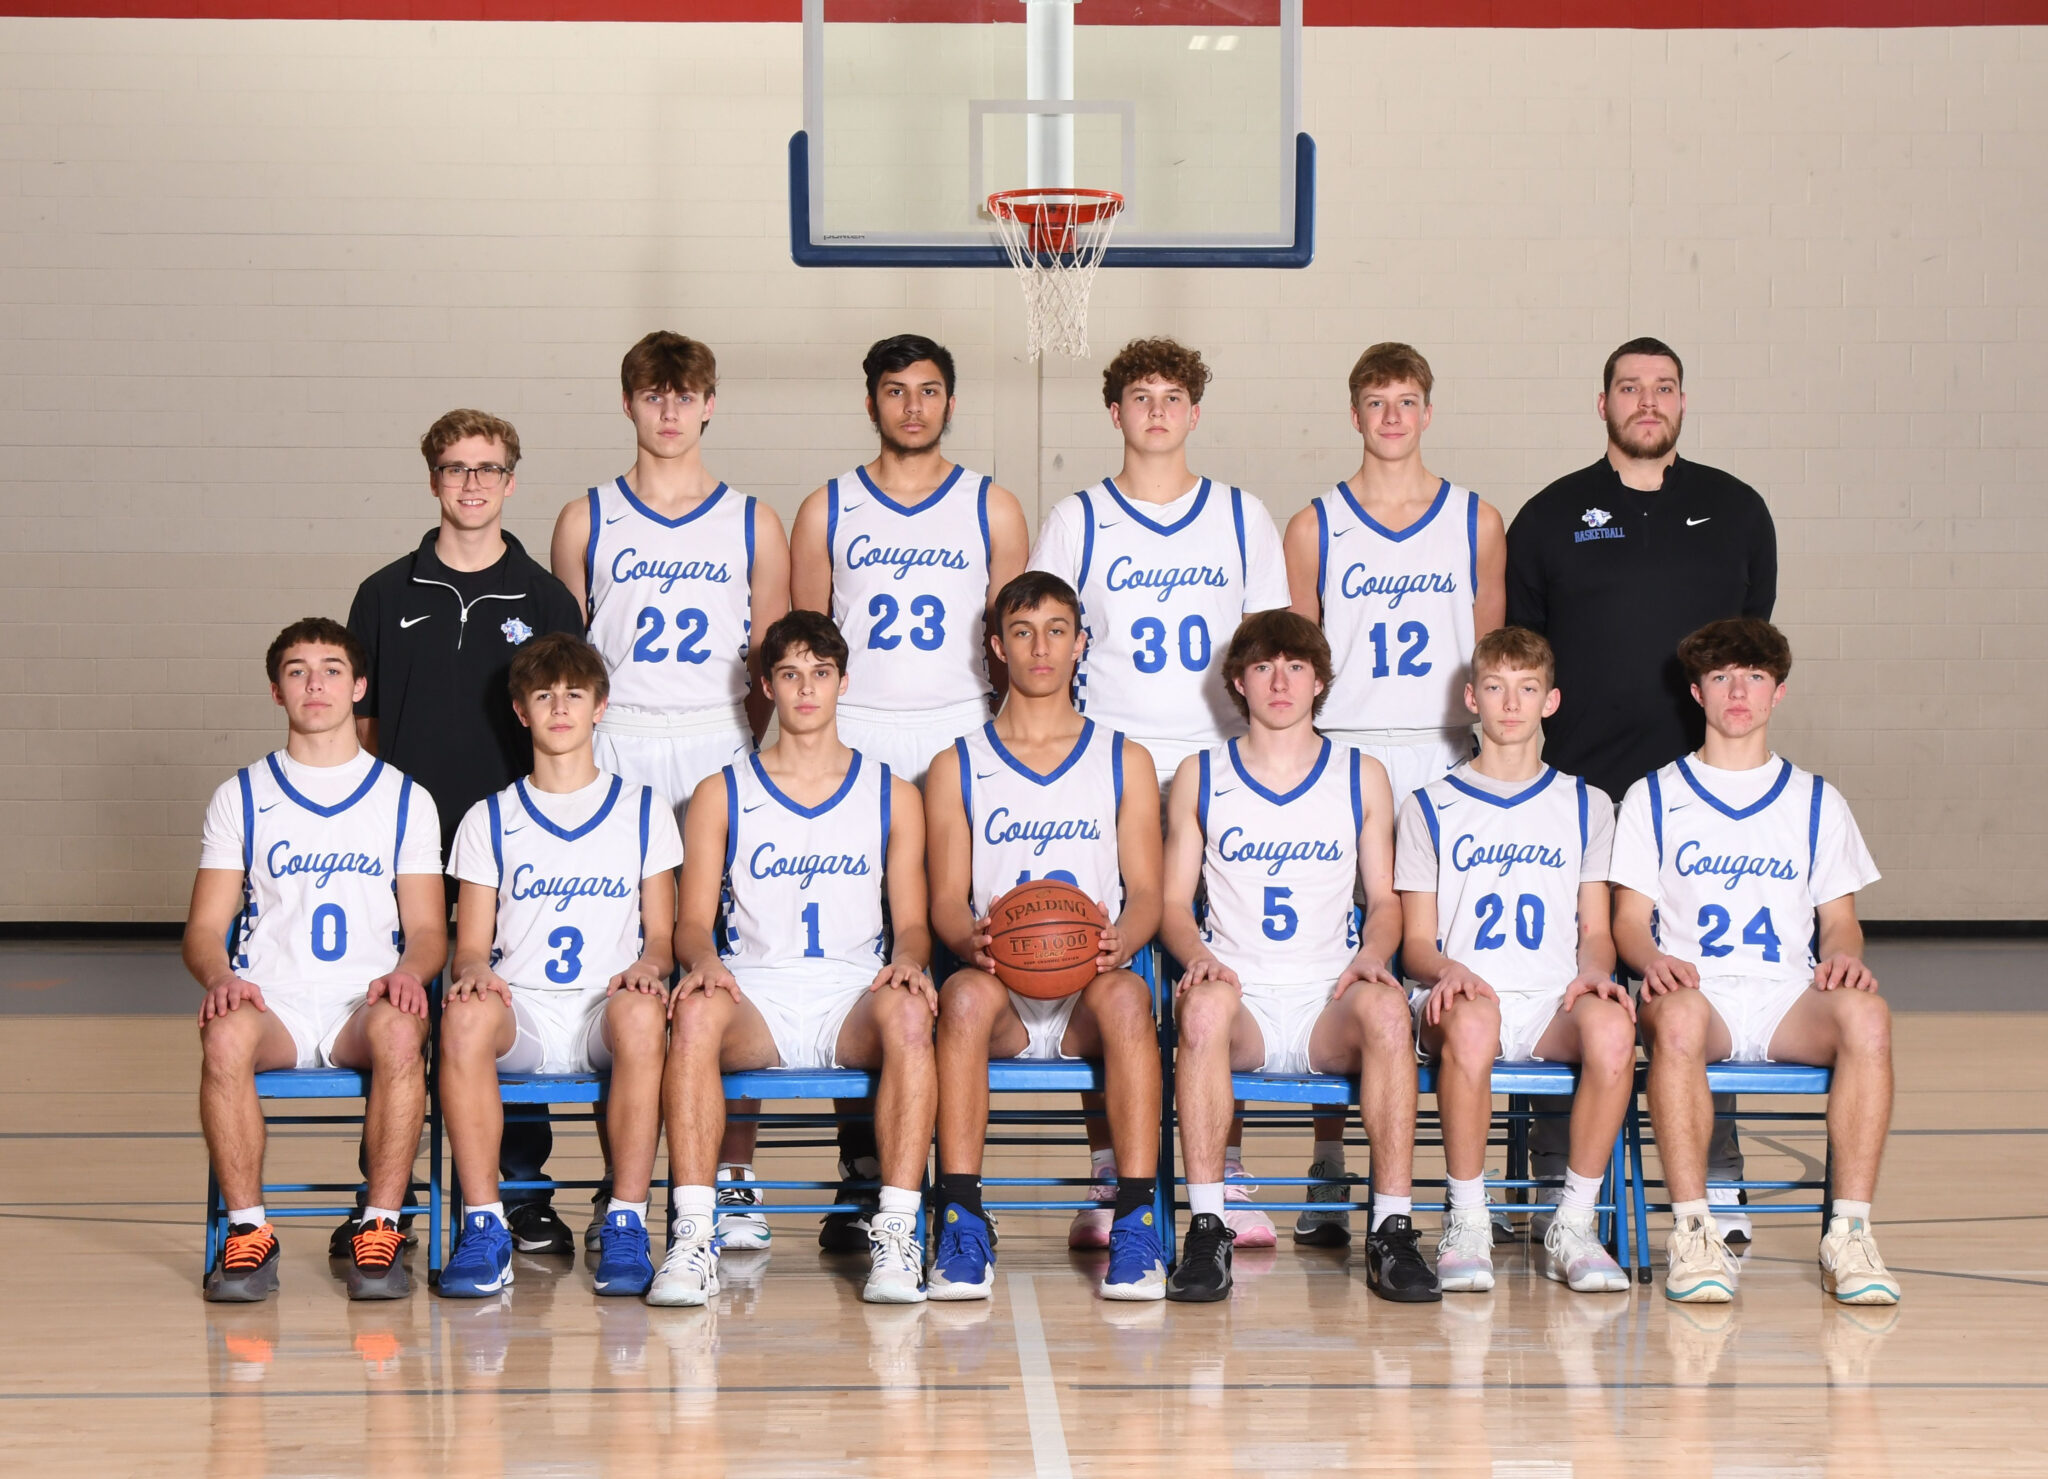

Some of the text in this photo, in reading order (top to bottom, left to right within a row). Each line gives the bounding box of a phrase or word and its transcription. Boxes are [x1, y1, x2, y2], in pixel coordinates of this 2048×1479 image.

[846, 534, 969, 580] Cougars
[1574, 527, 1626, 543] BASKETBALL
[611, 547, 730, 593] Cougars
[1106, 555, 1228, 602] Cougars
[1341, 562, 1455, 609] Cougars
[633, 606, 712, 664] 22
[867, 593, 946, 650] 23
[1130, 614, 1212, 673] 30
[1369, 620, 1433, 678] 12
[984, 807, 1100, 856] Cougars
[1218, 826, 1341, 875] Cougars
[1452, 833, 1565, 876] Cougars
[267, 840, 382, 888] Cougars
[511, 863, 631, 911] Cougars
[749, 842, 869, 889] Cougars
[1675, 840, 1799, 890] Cougars
[311, 902, 348, 961] 0
[801, 902, 825, 957] 1
[1005, 899, 1086, 926] SPALDING
[1261, 886, 1299, 941] 5
[1474, 892, 1545, 950] 20
[1697, 903, 1782, 962] 24
[544, 925, 585, 984] 3
